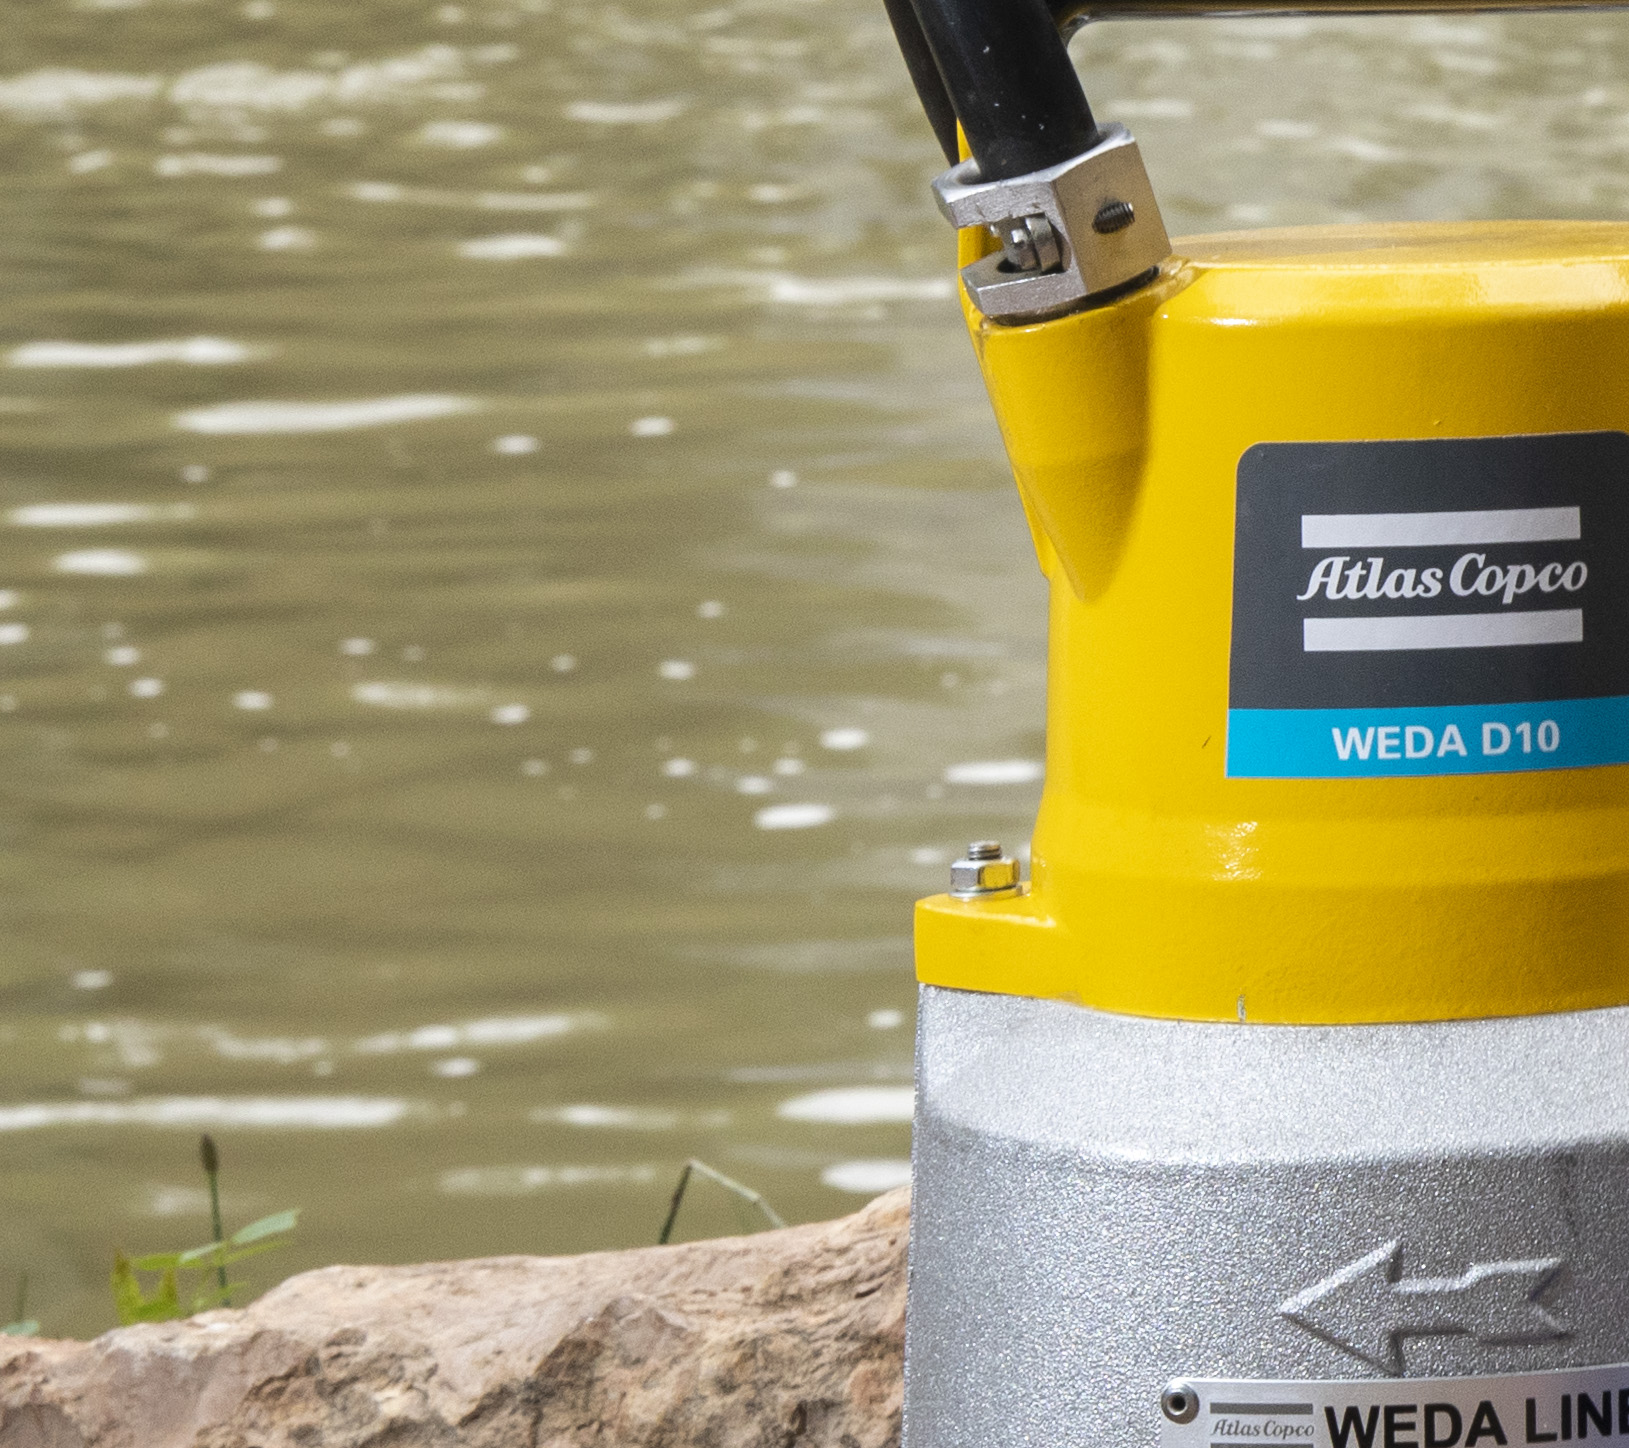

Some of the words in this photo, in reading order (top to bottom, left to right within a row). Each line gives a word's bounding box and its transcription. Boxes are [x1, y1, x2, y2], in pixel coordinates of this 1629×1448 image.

[1297, 555, 1442, 601] Atlas
[1448, 552, 1588, 604] Copco
[1332, 725, 1467, 761] WEDA
[1482, 719, 1560, 755] D10
[1210, 1418, 1260, 1437] Atlas
[1263, 1419, 1315, 1440] Copco
